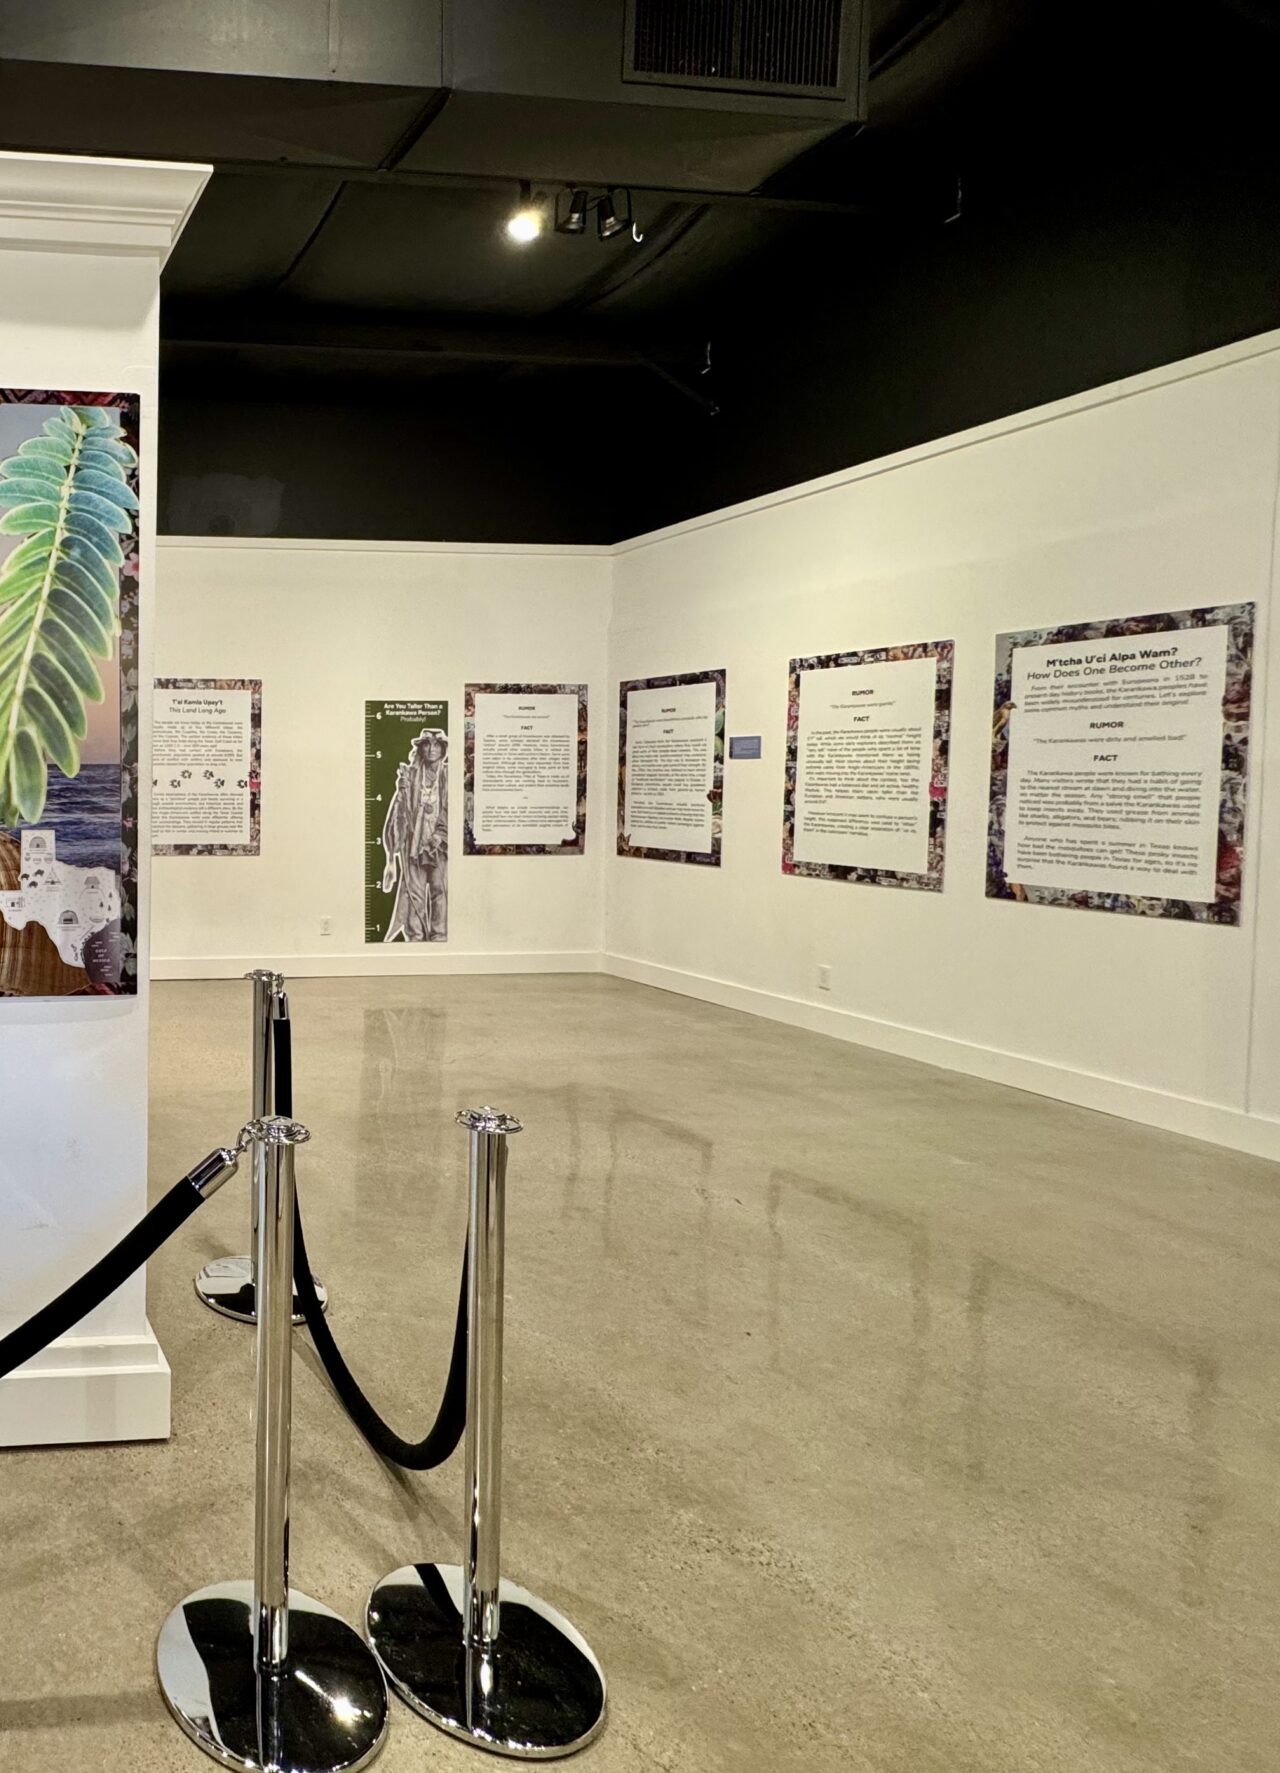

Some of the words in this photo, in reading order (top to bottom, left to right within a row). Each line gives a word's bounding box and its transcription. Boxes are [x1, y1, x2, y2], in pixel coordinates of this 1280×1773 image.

[1046, 657, 1083, 668] M'tcha
[1109, 652, 1136, 663] Alpa
[1139, 647, 1178, 659] Wam?
[1027, 672, 1051, 681] How
[1053, 669, 1080, 679] Does
[1083, 666, 1106, 676] One
[1109, 663, 1156, 673] Become
[1159, 657, 1202, 670] Other?
[376, 712, 382, 720] 6
[1089, 721, 1124, 729] RUMOR
[376, 751, 382, 759] 5
[1093, 754, 1118, 762] FACT
[376, 794, 382, 802] 4
[376, 837, 382, 845] 3
[376, 881, 382, 889] 2
